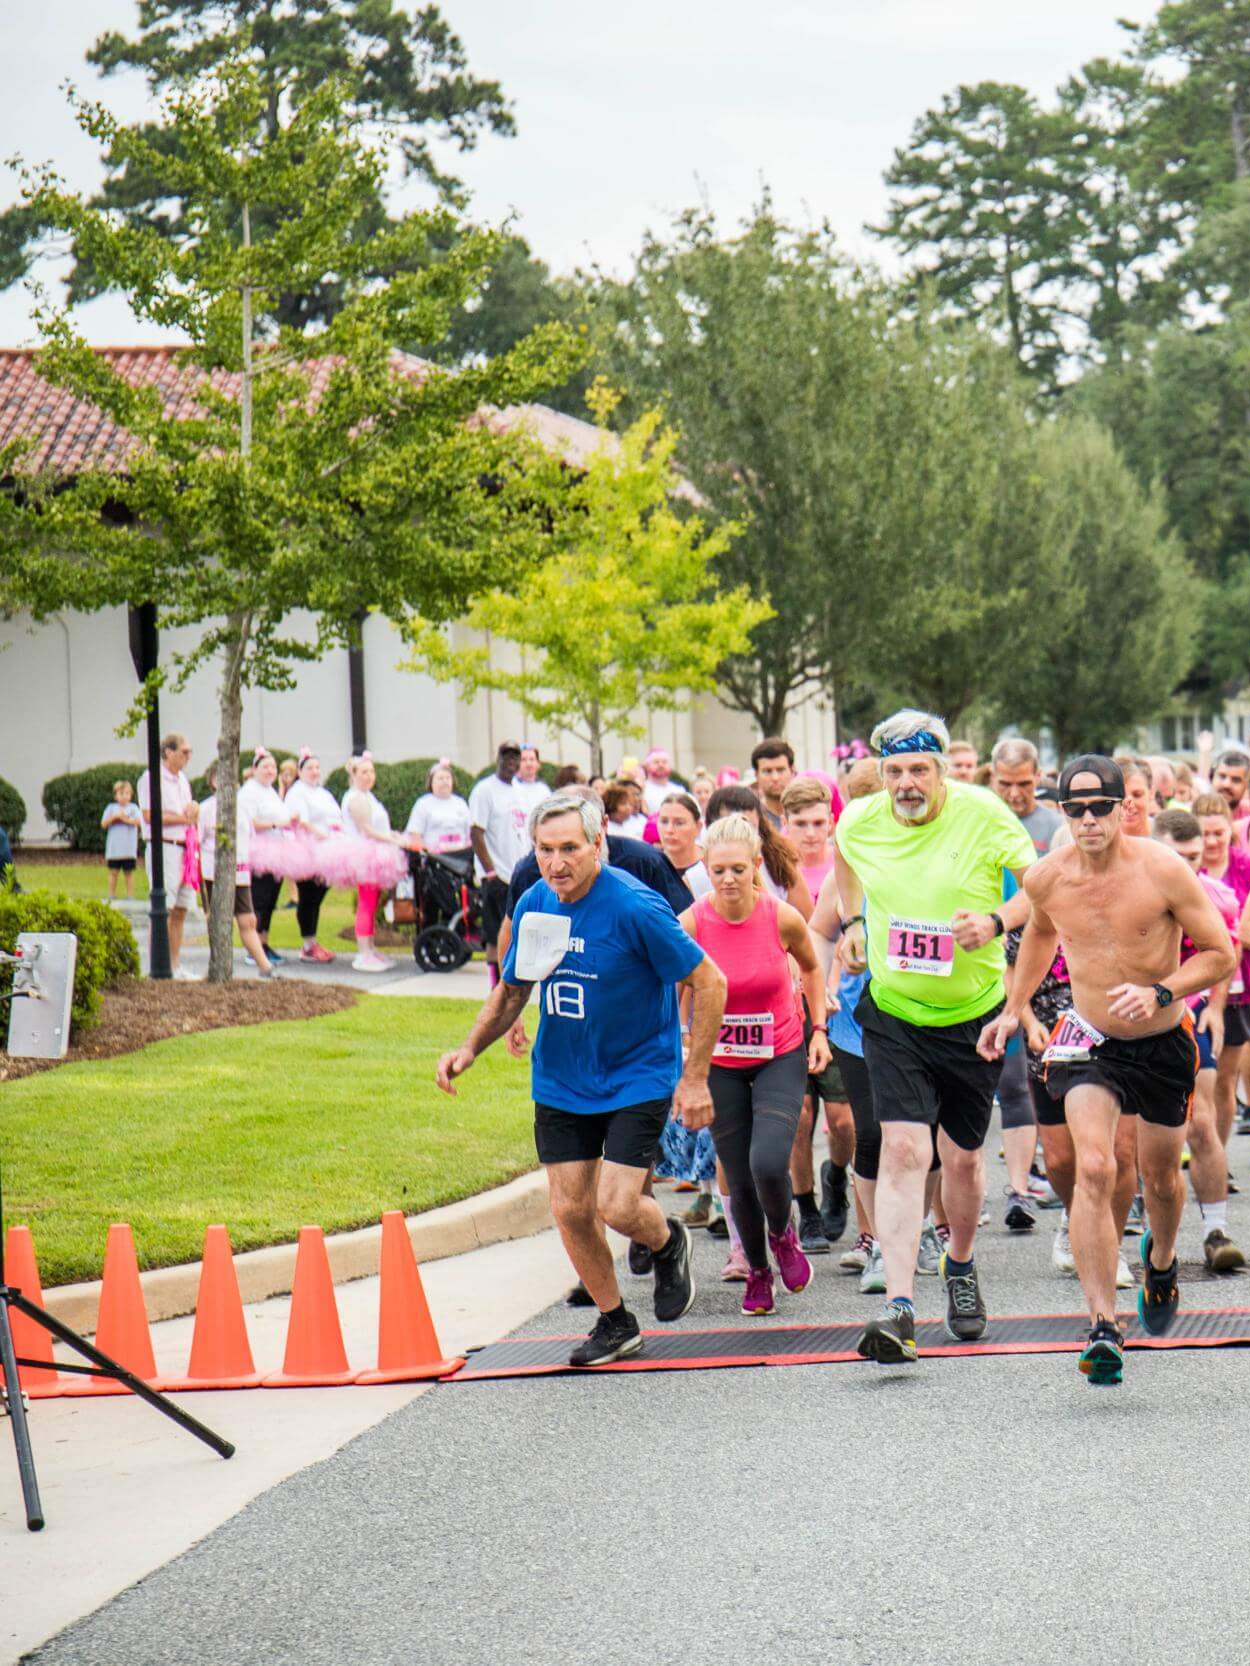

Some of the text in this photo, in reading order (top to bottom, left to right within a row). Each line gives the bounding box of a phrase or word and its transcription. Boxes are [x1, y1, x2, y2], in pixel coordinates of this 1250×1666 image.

[897, 931, 942, 961] 151
[720, 1024, 764, 1046] 209
[1053, 1020, 1086, 1046] 04
